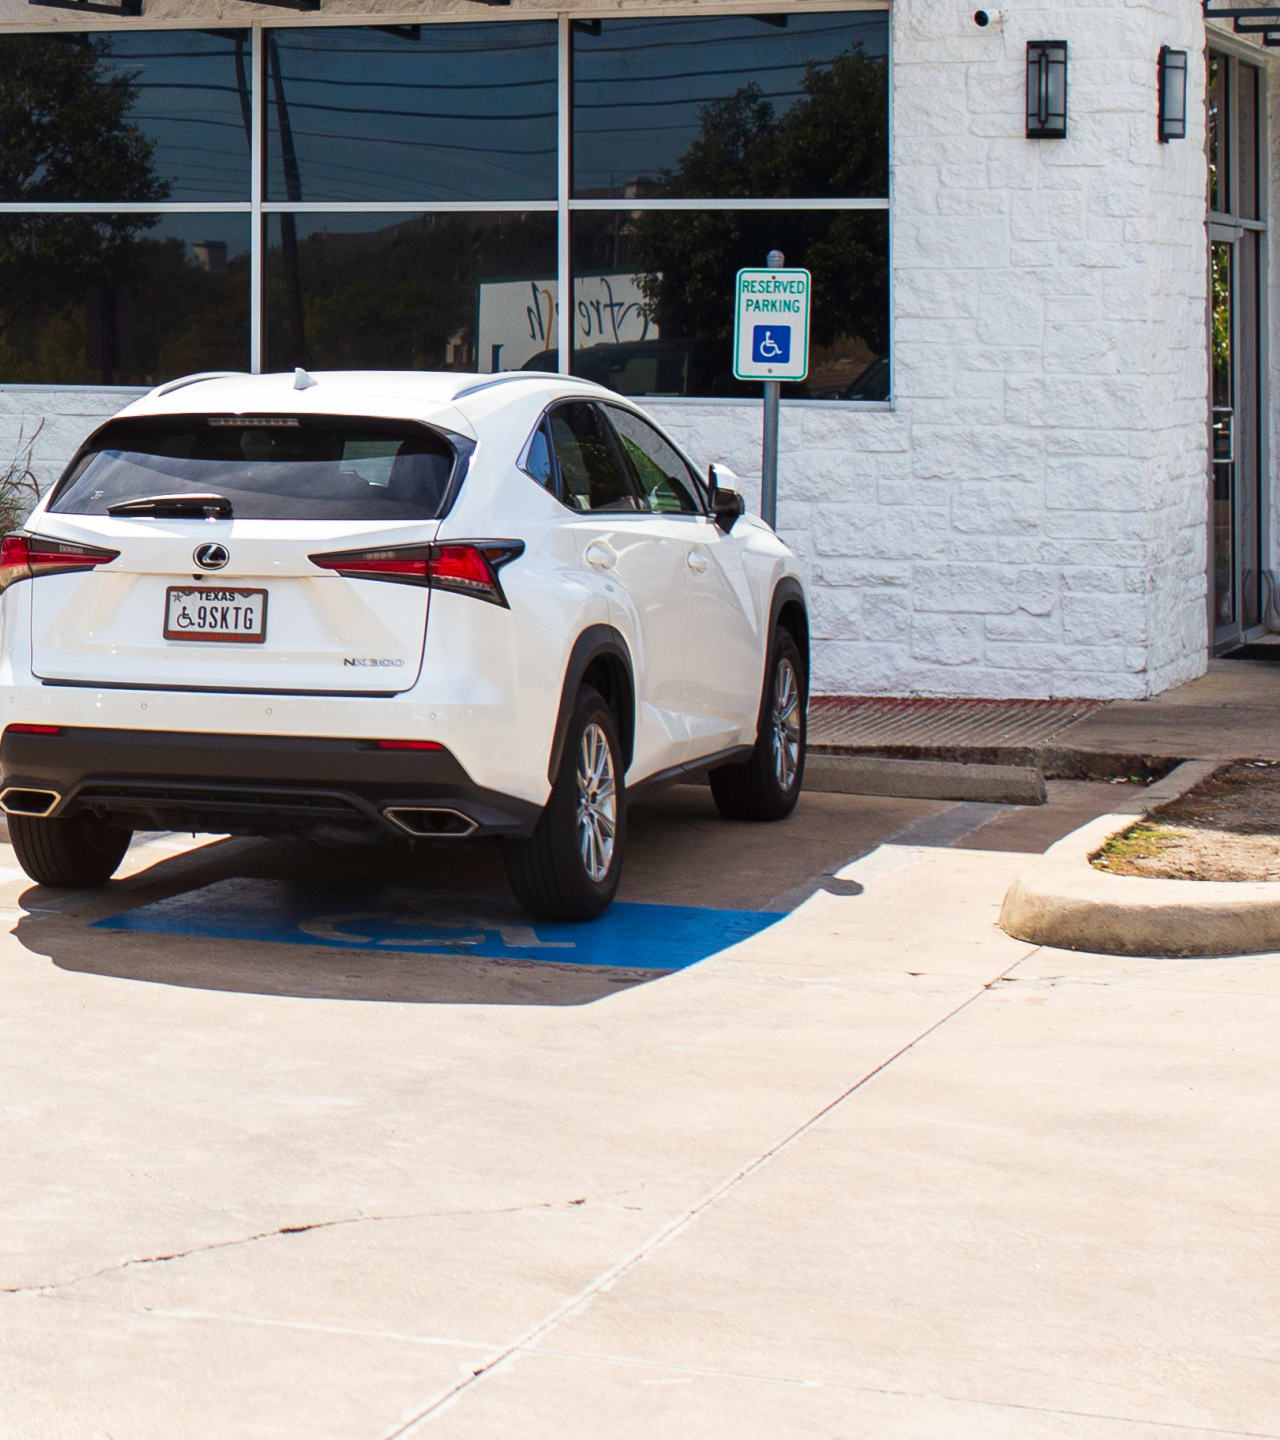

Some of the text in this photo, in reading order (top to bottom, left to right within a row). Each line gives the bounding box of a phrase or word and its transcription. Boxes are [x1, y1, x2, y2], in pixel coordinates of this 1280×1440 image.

[742, 280, 805, 294] RESERVED
[746, 299, 801, 313] PARKING
[198, 592, 236, 602] TEXAS
[197, 605, 254, 630] 9SKTG
